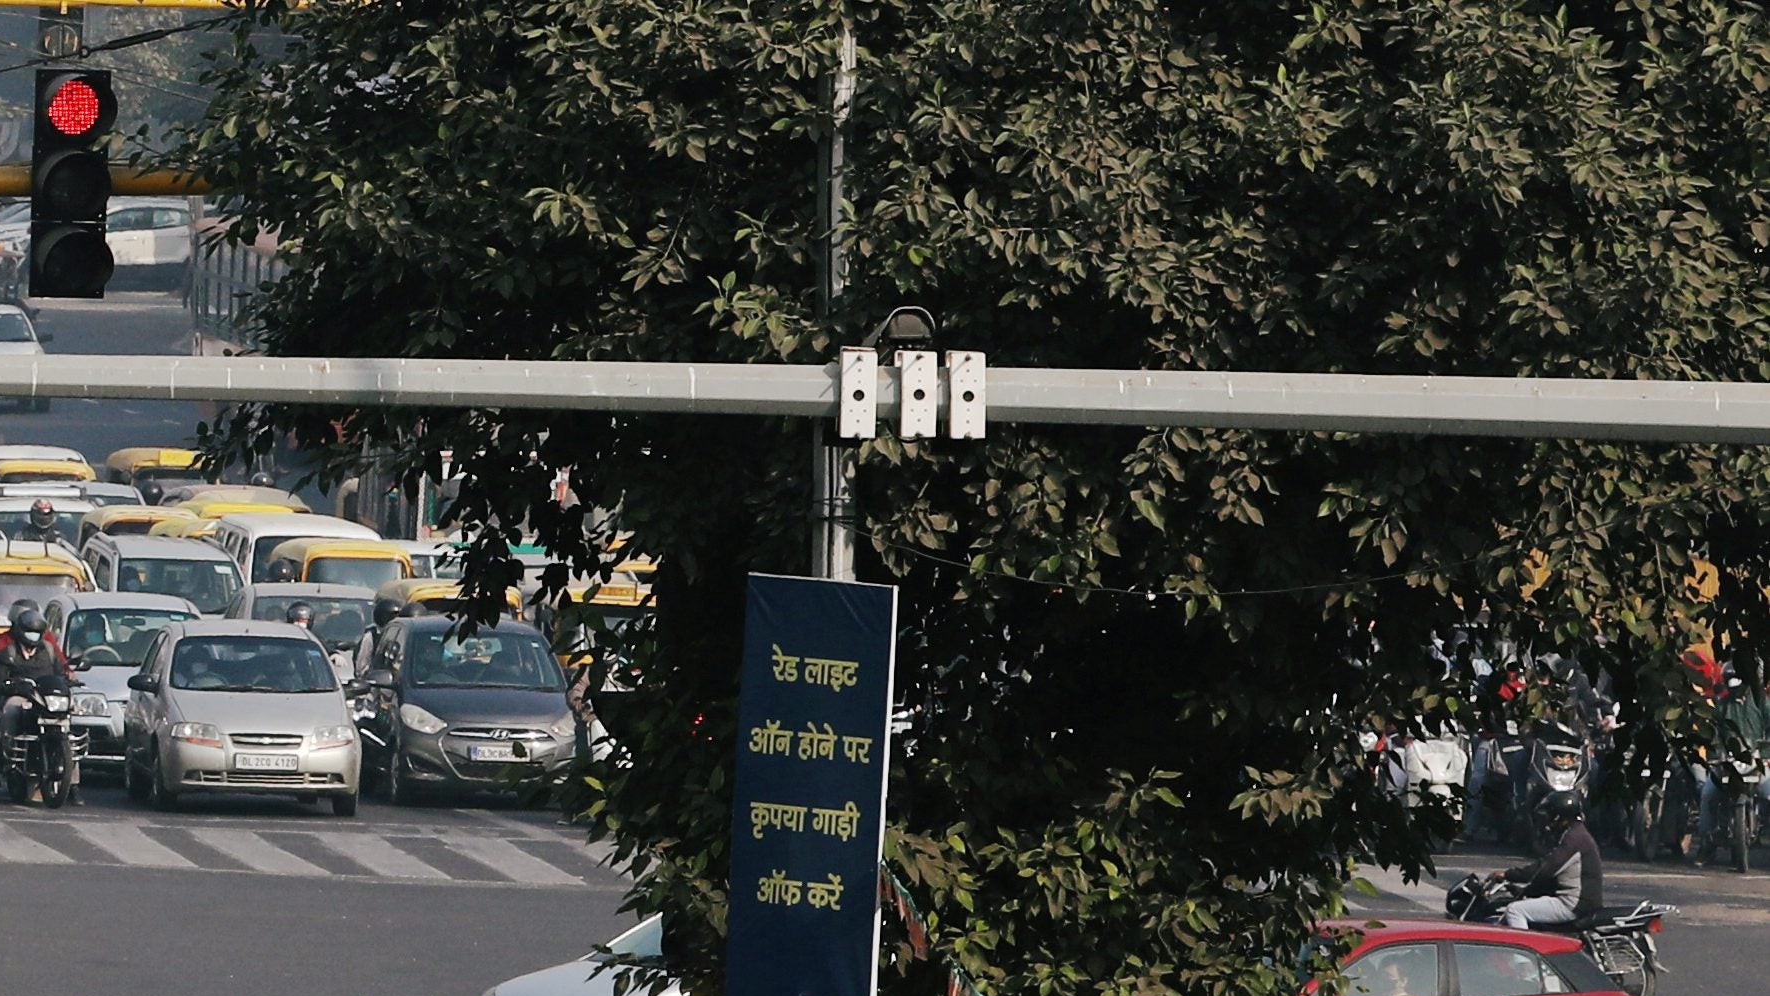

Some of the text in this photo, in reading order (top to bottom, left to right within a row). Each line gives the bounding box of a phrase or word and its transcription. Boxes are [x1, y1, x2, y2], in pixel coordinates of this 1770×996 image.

[771, 643, 859, 693] रेड लाइट
[748, 719, 873, 764] ऑन होने पर
[749, 801, 861, 842] कृपया गाड़ी
[756, 869, 845, 911] ऑफ करें
